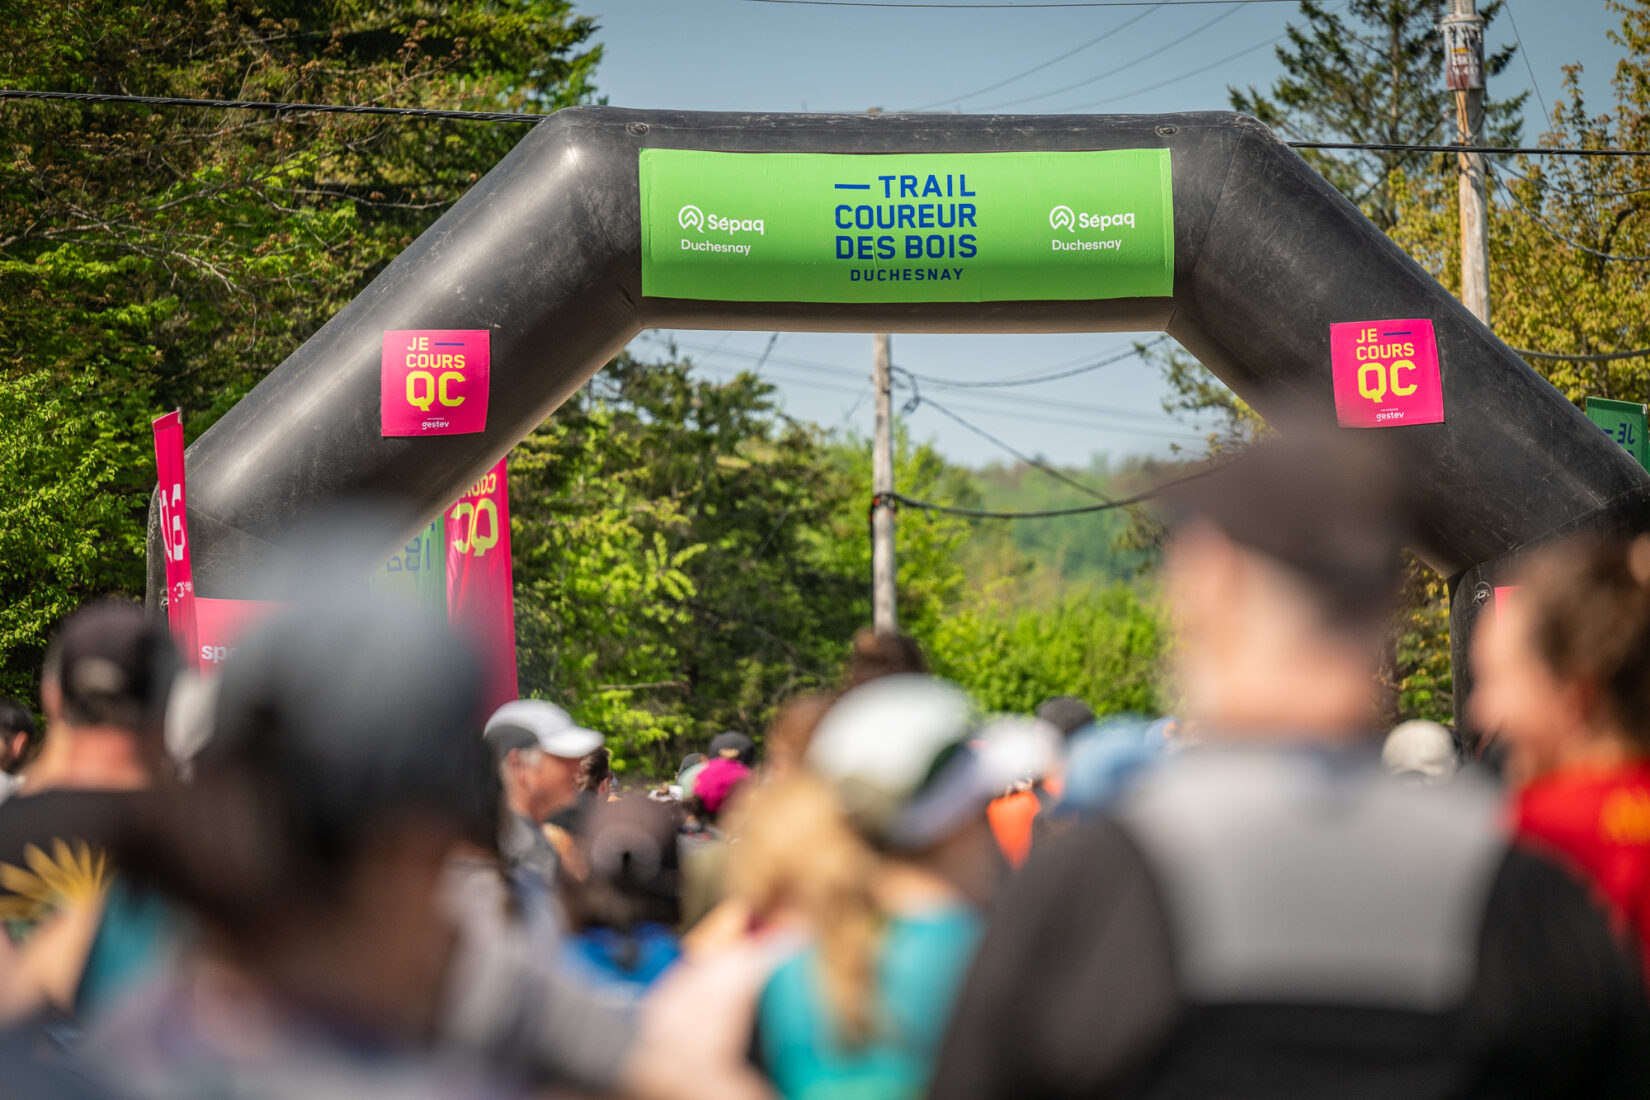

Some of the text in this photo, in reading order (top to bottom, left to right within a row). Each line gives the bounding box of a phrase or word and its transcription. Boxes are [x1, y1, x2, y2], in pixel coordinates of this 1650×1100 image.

[877, 174, 976, 198] TRAIL
[707, 214, 764, 235] Sépaq
[835, 203, 977, 229] COUREUR
[1078, 212, 1135, 231] Sépaq
[681, 239, 751, 256] Duchesnay
[835, 234, 978, 260] DES BOIS
[1051, 239, 1122, 252] Duchesnay
[850, 268, 964, 281] DUCHESNAY
[406, 337, 429, 352] JE
[1356, 328, 1377, 343] JE
[1356, 342, 1415, 361] COURS
[406, 353, 466, 369] COURS
[1357, 359, 1418, 403] QC
[406, 370, 466, 412] QC
[421, 420, 450, 431] gestev
[1376, 411, 1405, 422] gestev
